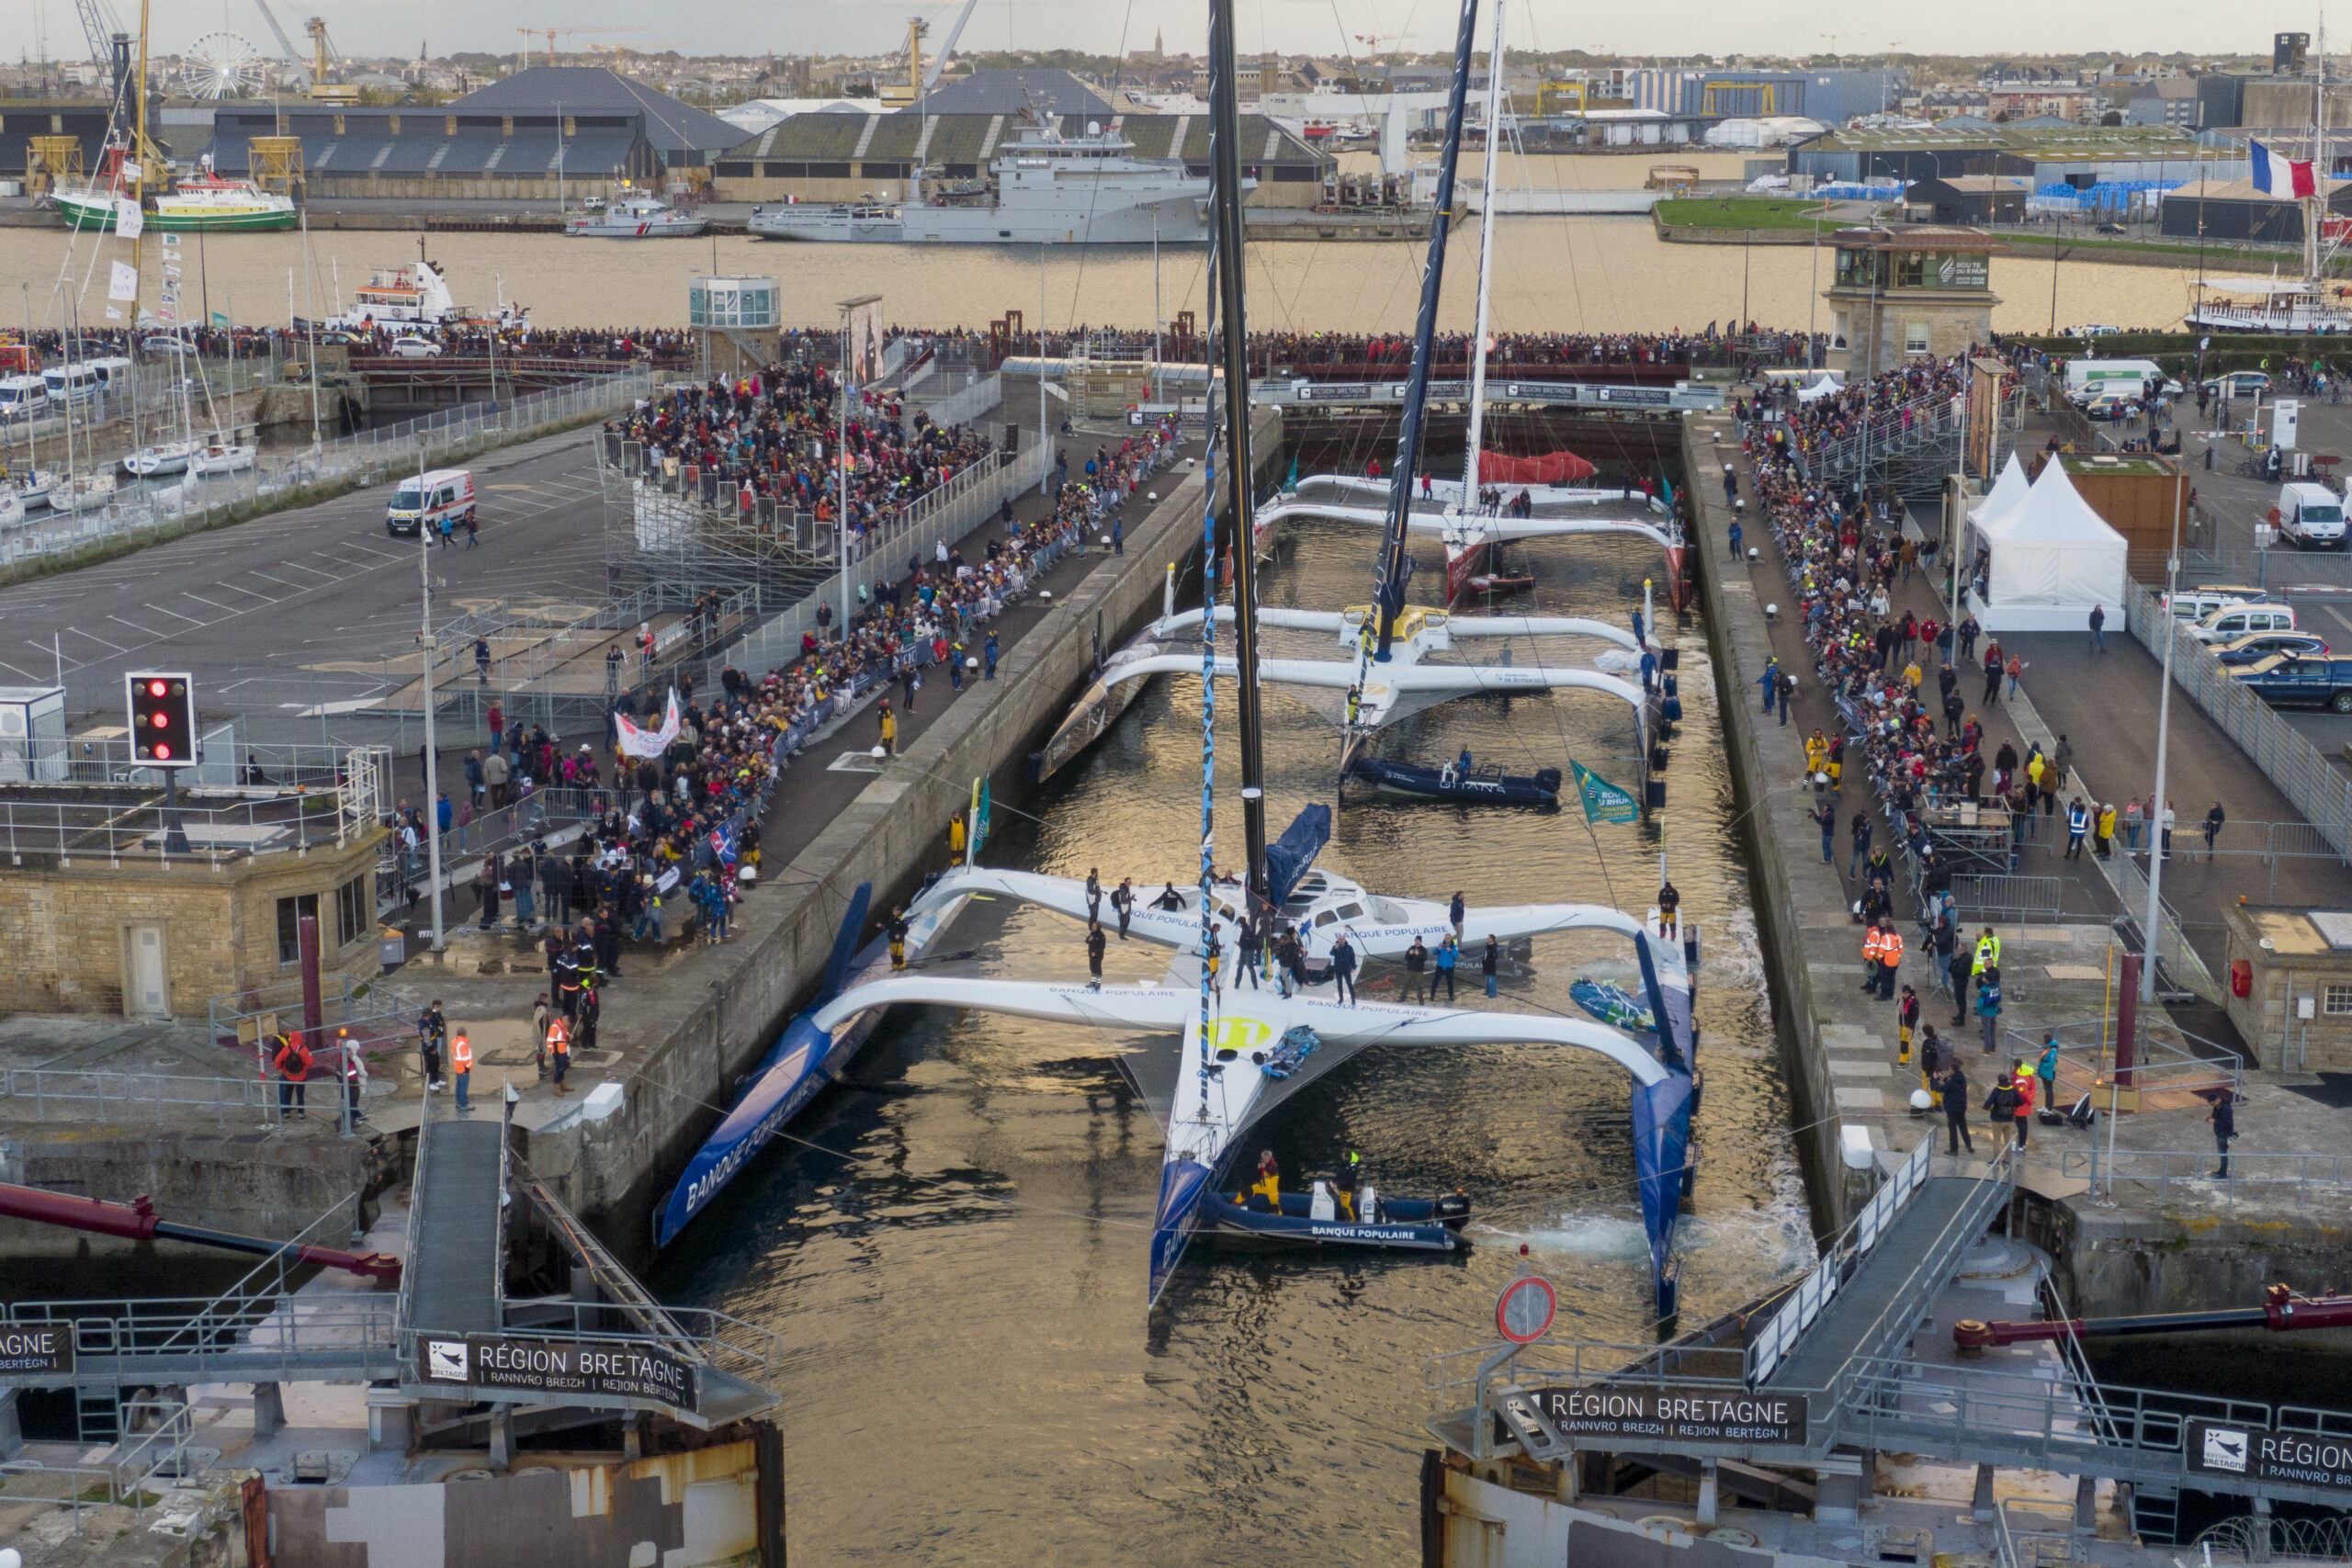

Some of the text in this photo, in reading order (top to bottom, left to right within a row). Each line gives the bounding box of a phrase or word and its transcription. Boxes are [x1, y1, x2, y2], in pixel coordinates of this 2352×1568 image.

[1520, 385, 1541, 393] RÉGION
[1611, 389, 1634, 397] RÉGION
[1181, 413, 1206, 422] ETAGNE
[1385, 925, 1449, 936] POPULAIRE
[1105, 989, 1176, 998] POPULAIRE
[1362, 1006, 1430, 1017] POPULAIRE
[1212, 1021, 1260, 1045] 11
[686, 1138, 747, 1213] BANQUE
[1311, 1226, 1416, 1240] BANQUE POPULAIRE
[480, 1343, 684, 1391] RÉGION BRETAGNE
[491, 1372, 542, 1386] RANNVRO
[546, 1378, 585, 1389] BREIZH
[1552, 1390, 1789, 1424] RÉGION BRETAGNE
[1561, 1419, 1617, 1432] RANNVRO
[1623, 1422, 1665, 1435] BREIZH
[2261, 1436, 2352, 1470] RÉGION
[2269, 1465, 2330, 1483] RANNVRO
